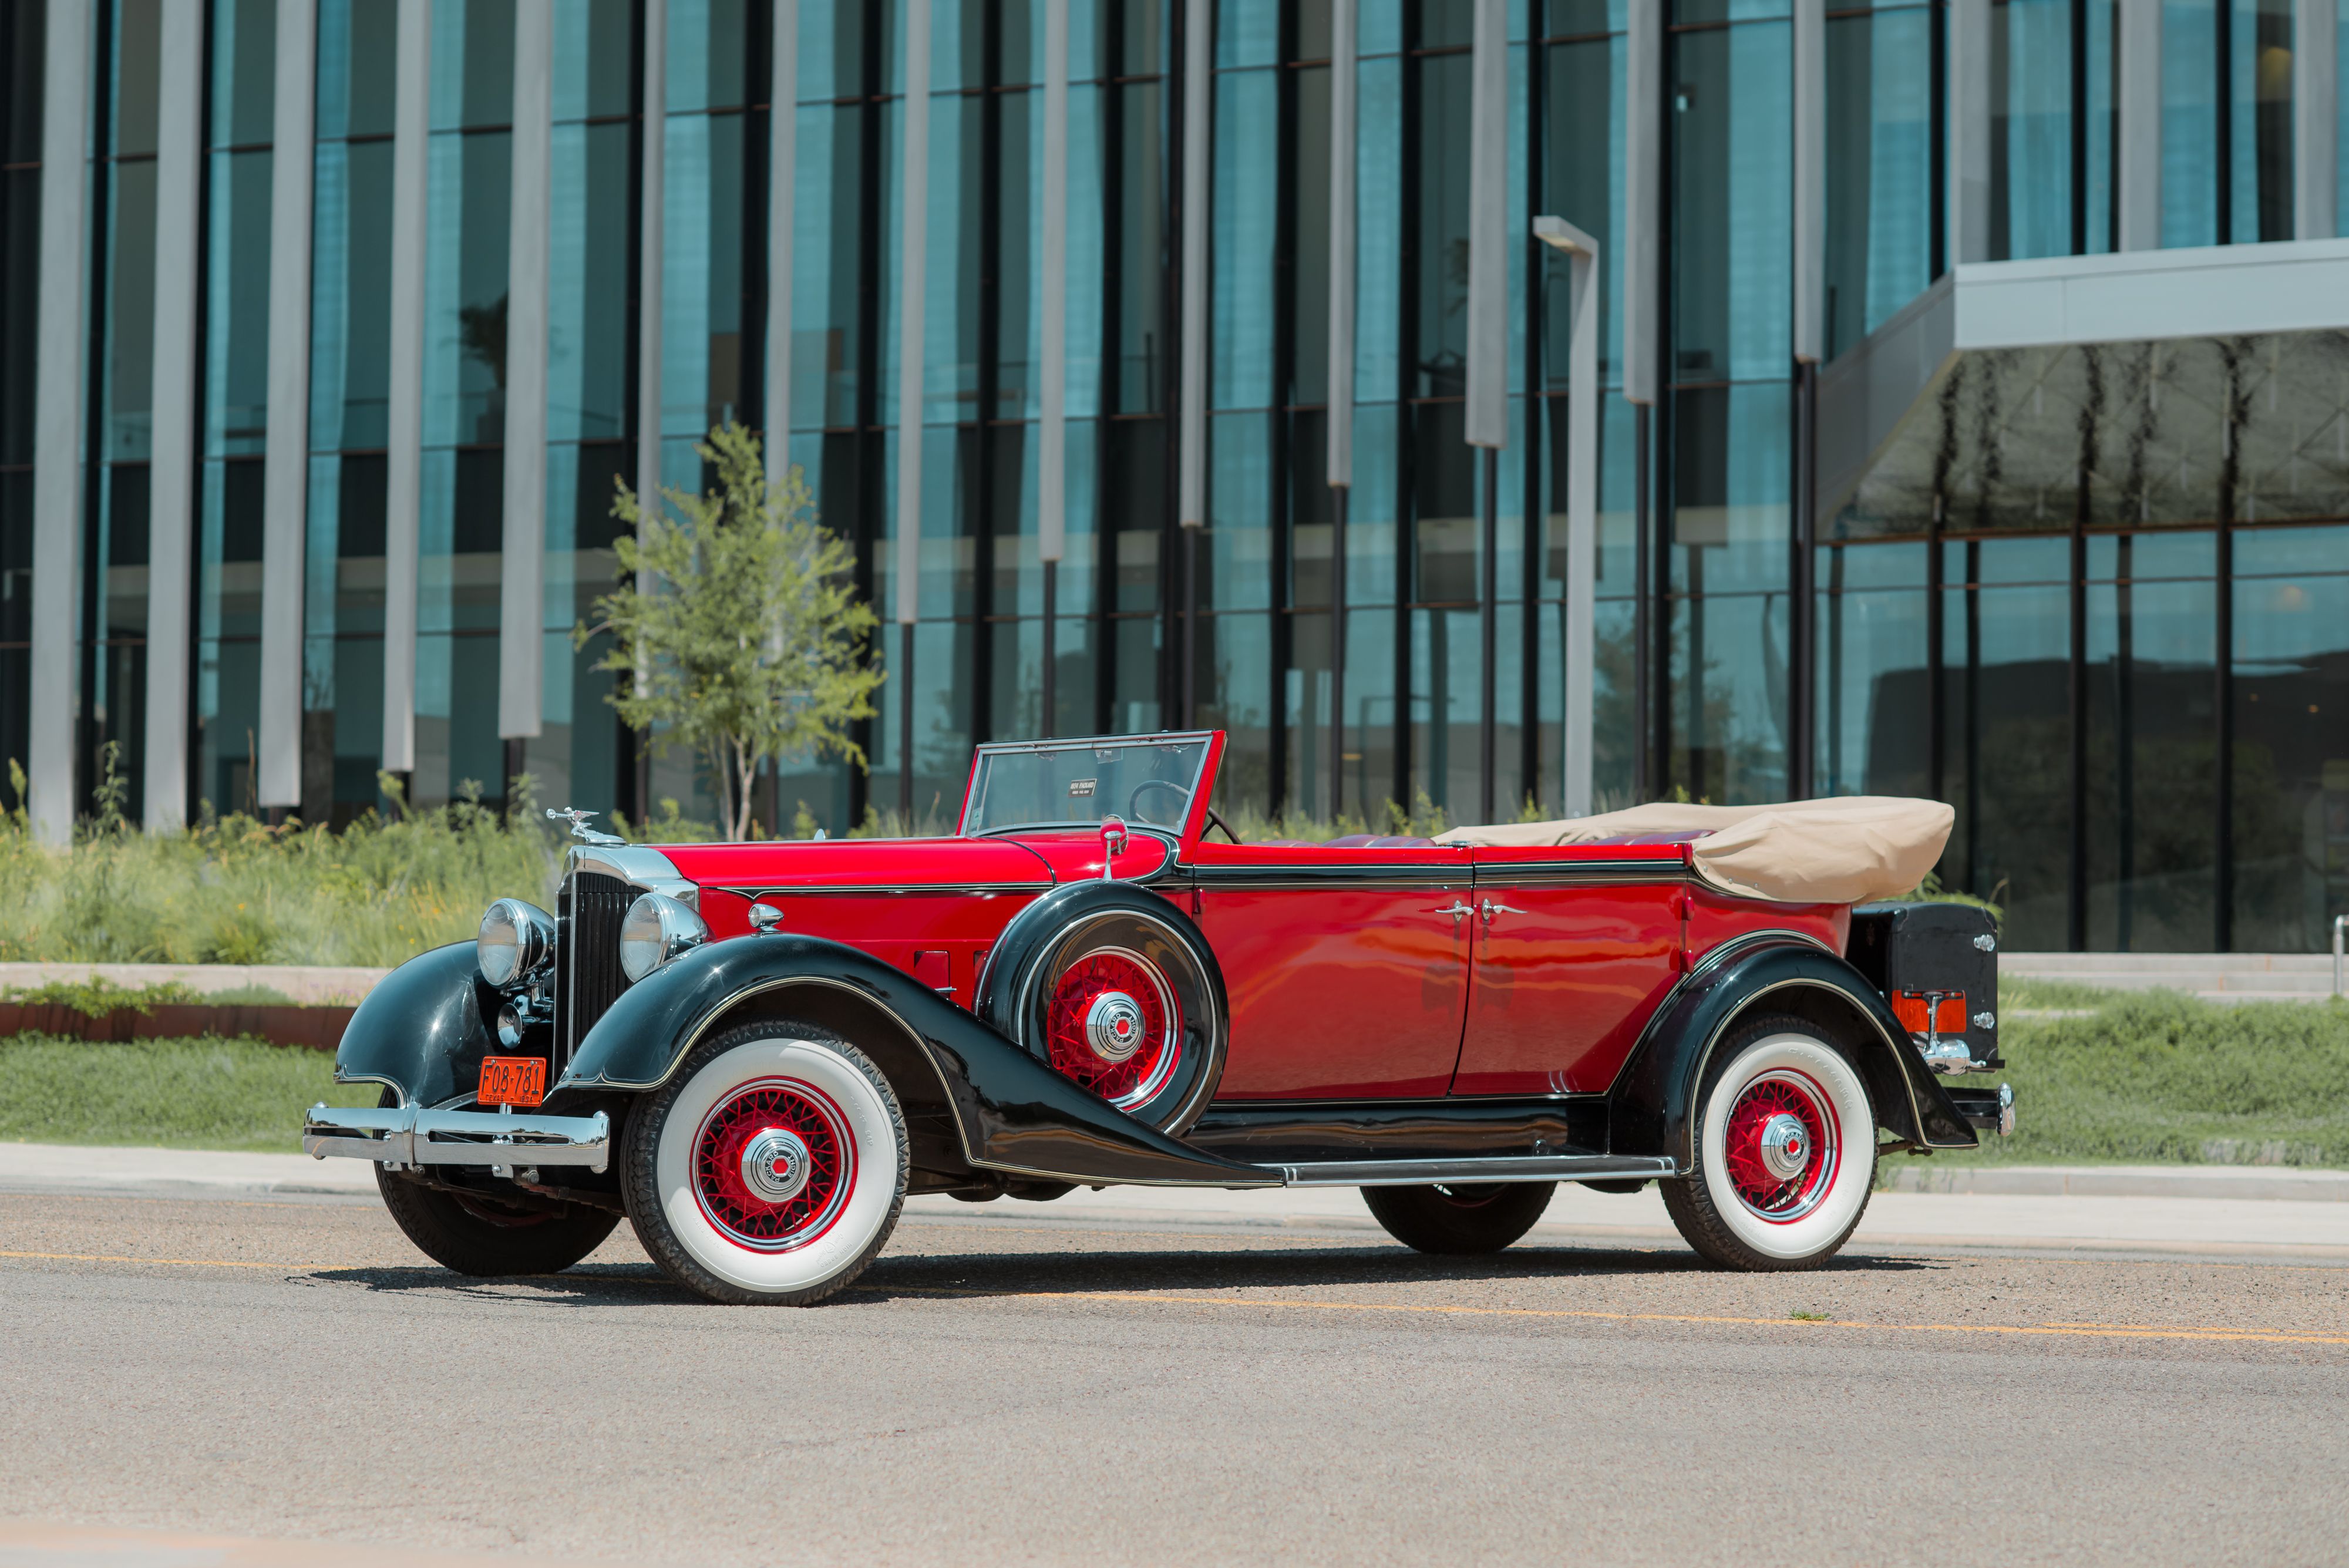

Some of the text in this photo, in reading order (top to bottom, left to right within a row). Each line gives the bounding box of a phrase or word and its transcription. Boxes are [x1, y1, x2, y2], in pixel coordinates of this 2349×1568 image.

[1110, 1013, 1123, 1042] PACKARD
[1128, 1015, 1136, 1038] EIGHT
[765, 1151, 780, 1182] PACKARD
[788, 1155, 796, 1178] EIGHT
